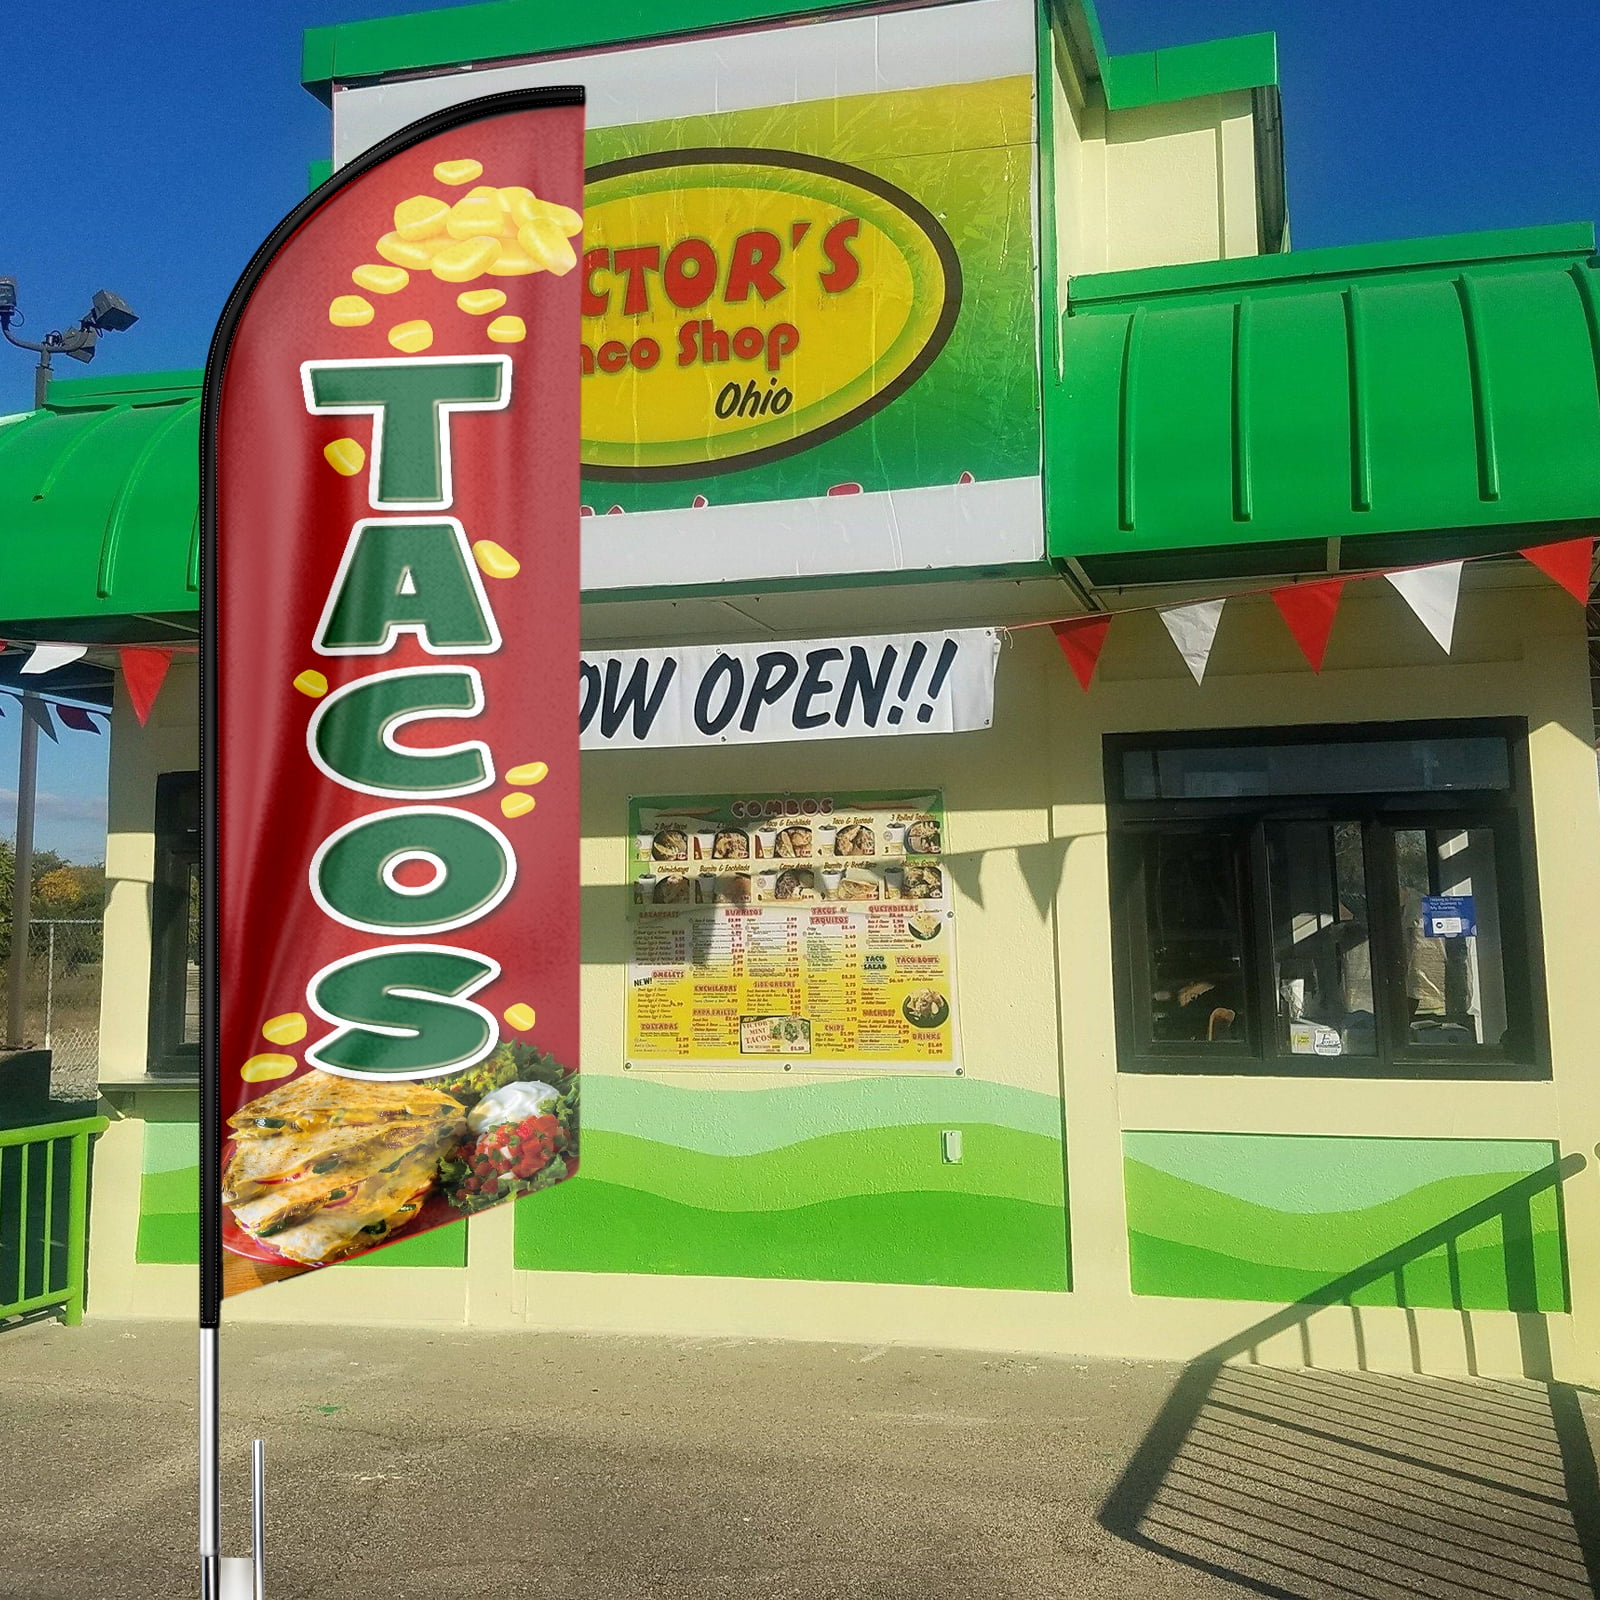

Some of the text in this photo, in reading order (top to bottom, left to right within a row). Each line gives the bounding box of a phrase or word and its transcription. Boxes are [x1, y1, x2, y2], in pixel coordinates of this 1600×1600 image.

[678, 319, 800, 371] Shop
[714, 377, 794, 420] Ohio
[693, 638, 959, 737] OPEN!!
[300, 354, 517, 1081] TACOS
[730, 797, 834, 819] COMBOS
[634, 977, 653, 987] NEW!
